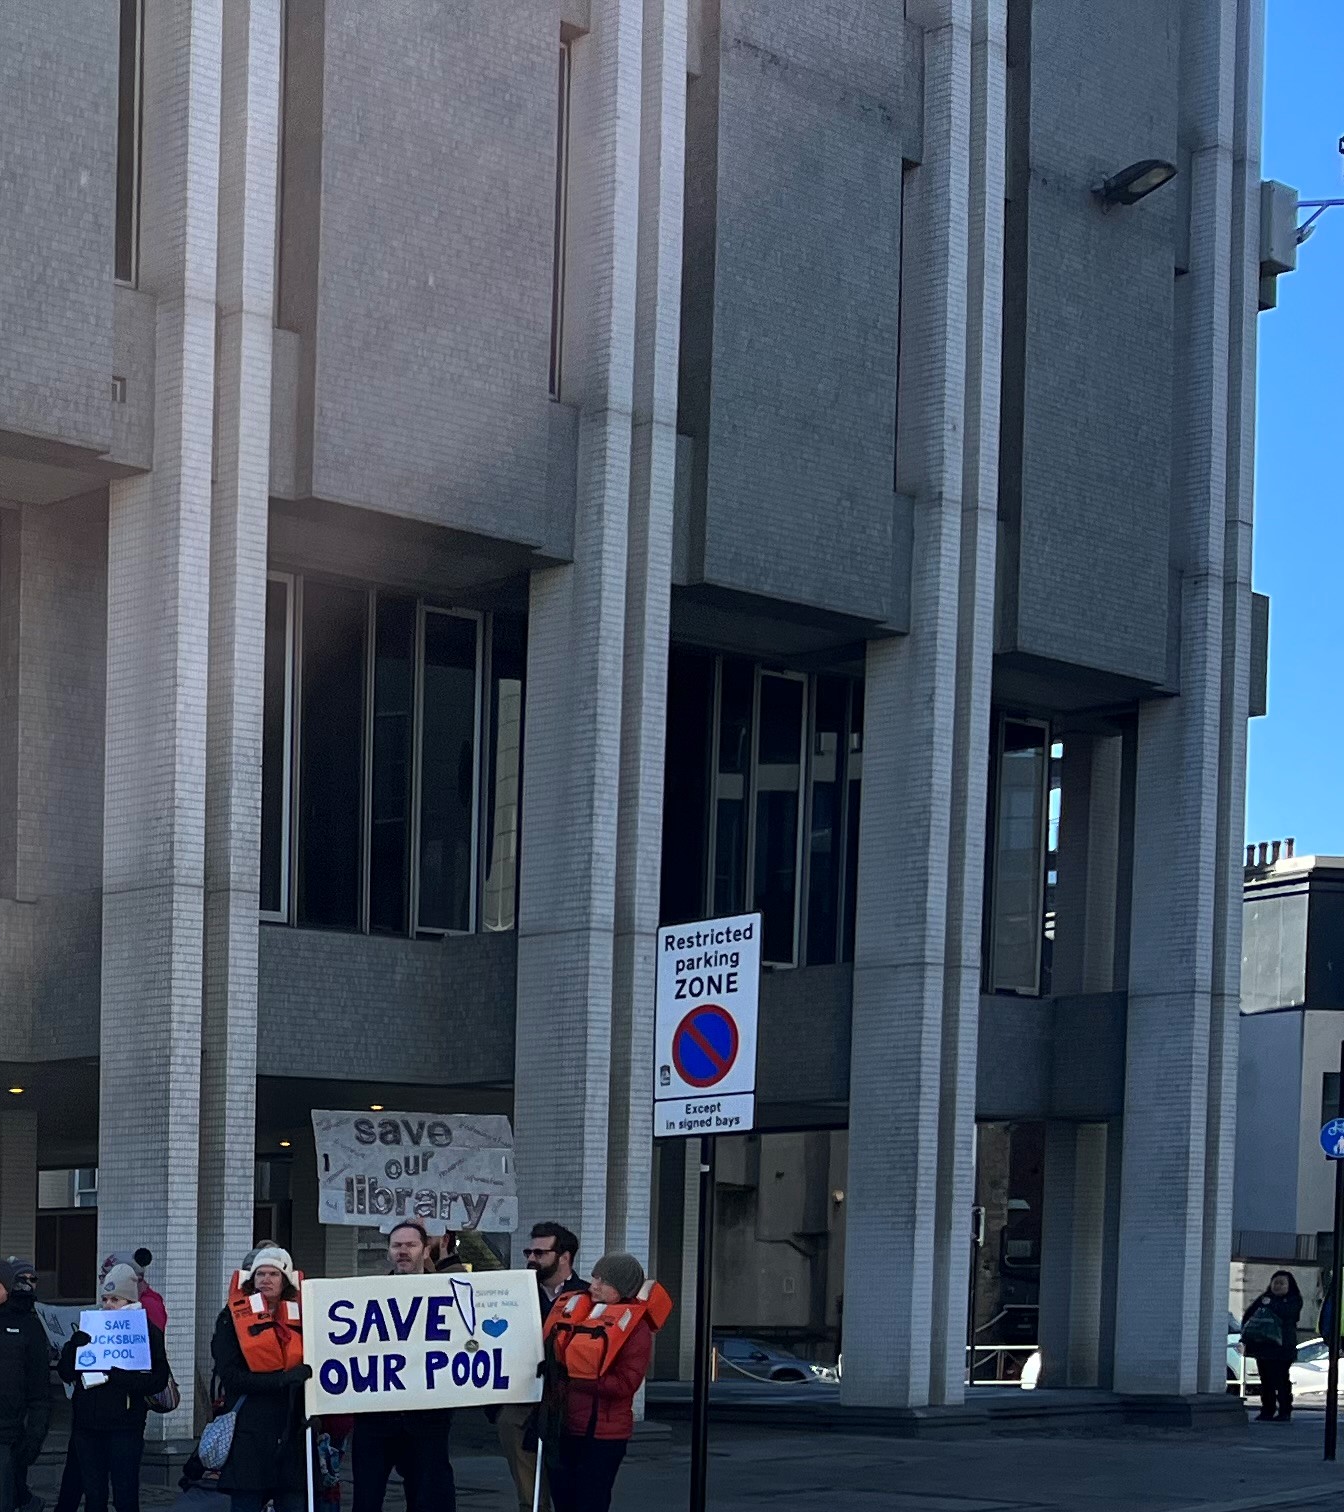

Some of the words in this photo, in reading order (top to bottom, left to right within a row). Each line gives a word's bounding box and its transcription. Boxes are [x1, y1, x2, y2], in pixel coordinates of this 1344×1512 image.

[664, 922, 754, 952] Restricted
[675, 950, 740, 976] parking
[674, 971, 739, 1000] ZONE
[685, 1101, 722, 1115] Except
[353, 1117, 454, 1148] save
[665, 1119, 676, 1130] in
[678, 1116, 713, 1131] signed
[715, 1115, 741, 1128] bays
[383, 1150, 437, 1180] our
[344, 1173, 490, 1231] library
[104, 1319, 131, 1331] SAVE
[91, 1334, 147, 1345] UCKSBURN
[102, 1349, 136, 1360] POOL
[319, 1352, 408, 1396] OUR
[425, 1347, 511, 1391] POOL
